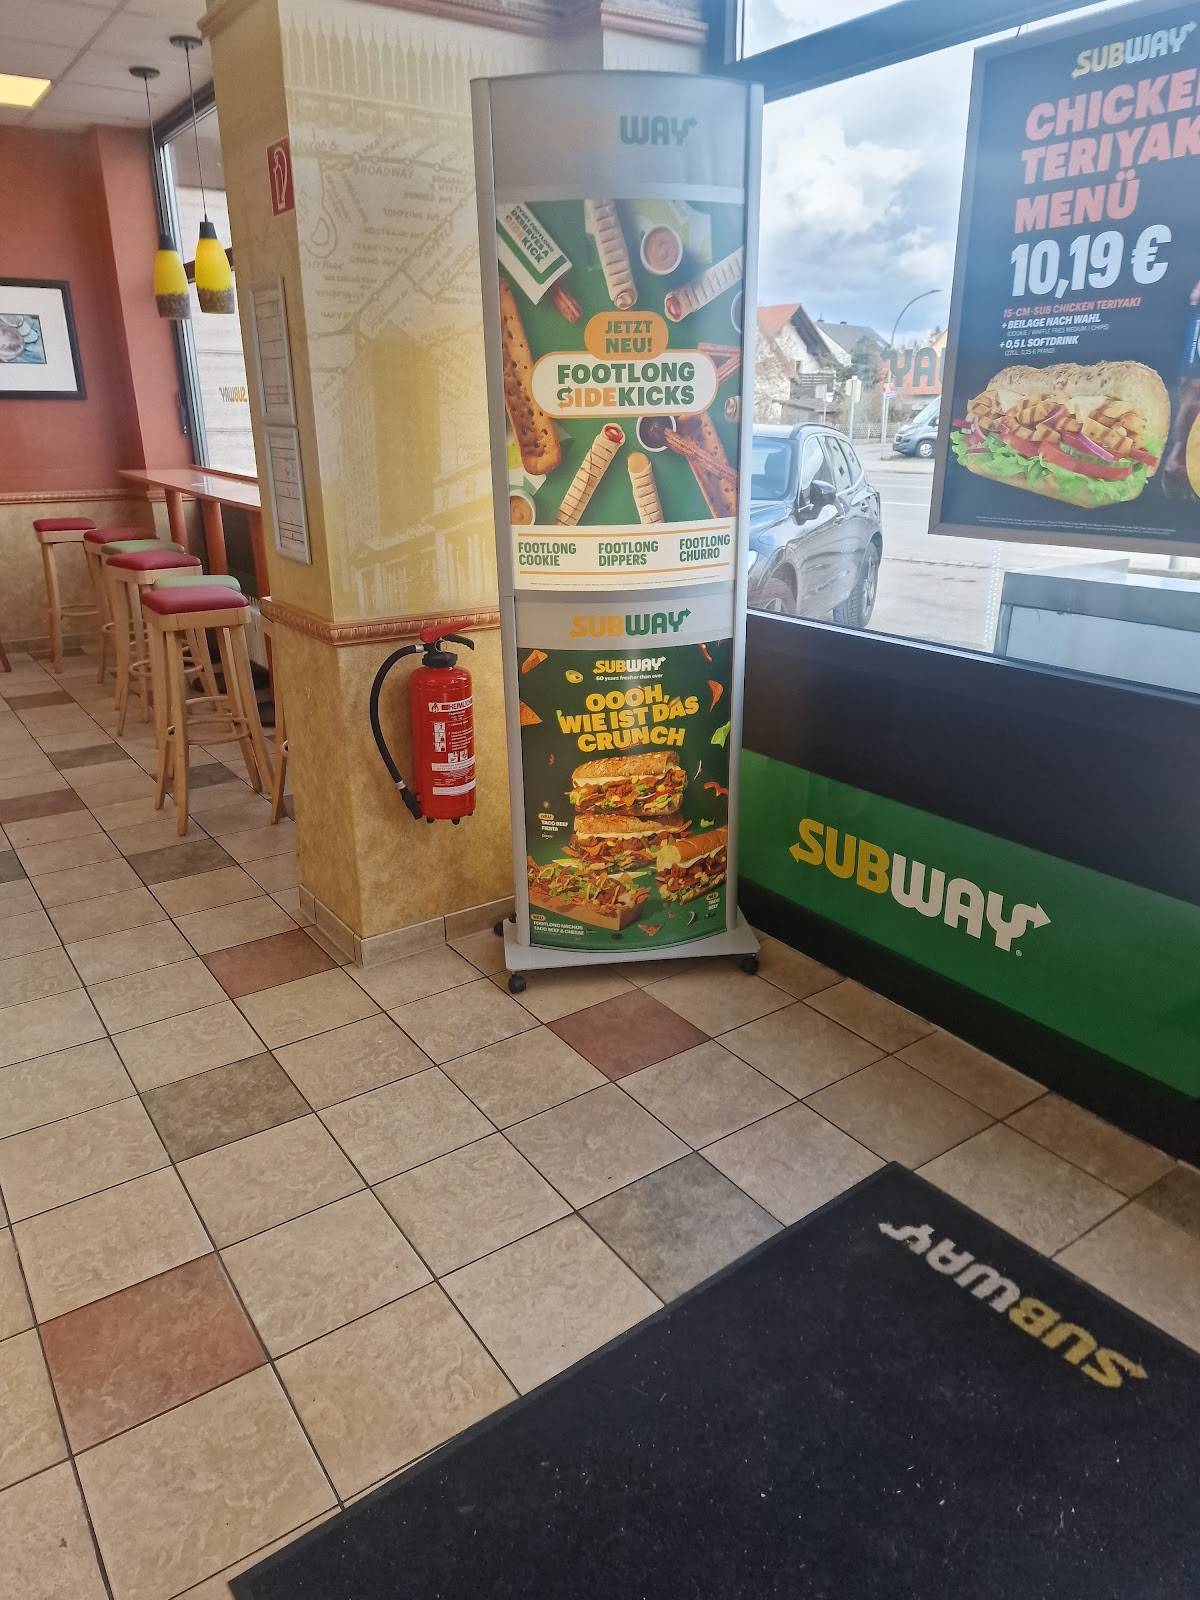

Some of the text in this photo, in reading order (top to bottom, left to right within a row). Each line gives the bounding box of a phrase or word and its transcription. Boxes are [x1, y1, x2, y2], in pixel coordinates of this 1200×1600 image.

[1071, 21, 1198, 79] SUBWAY
[1026, 68, 1200, 141] CHICKE
[352, 164, 416, 179] BROADWAY
[1015, 169, 1140, 234] MENÜ
[1010, 224, 1172, 299] 10,19 €
[1053, 301, 1095, 314] CHICKEN
[1097, 297, 1142, 311] TERIYAKI
[605, 320, 653, 335] JETZT
[1046, 315, 1074, 326] NACH
[1073, 313, 1102, 324] WAHL
[605, 337, 653, 353] NEU!
[1026, 335, 1080, 348] SOFTDRINK
[557, 361, 695, 385] FOOTLONG
[556, 386, 695, 409] SIDEKICKS
[518, 542, 577, 555] FOOTLONG
[598, 540, 659, 555] FOOTLONG
[679, 534, 731, 550] FOOTLONG
[518, 555, 561, 567] COOKIE
[599, 554, 647, 567] DIPPERS
[679, 547, 721, 562] CHURRO
[568, 607, 692, 639] SUBWAY
[592, 656, 667, 674] SUBWAY
[586, 683, 670, 712] OOOH,
[557, 695, 700, 734] WIE IST DAS
[578, 726, 685, 752] CRUNCH
[788, 818, 1051, 952] SUBWAY
[878, 1221, 1149, 1388] SUBWAY
